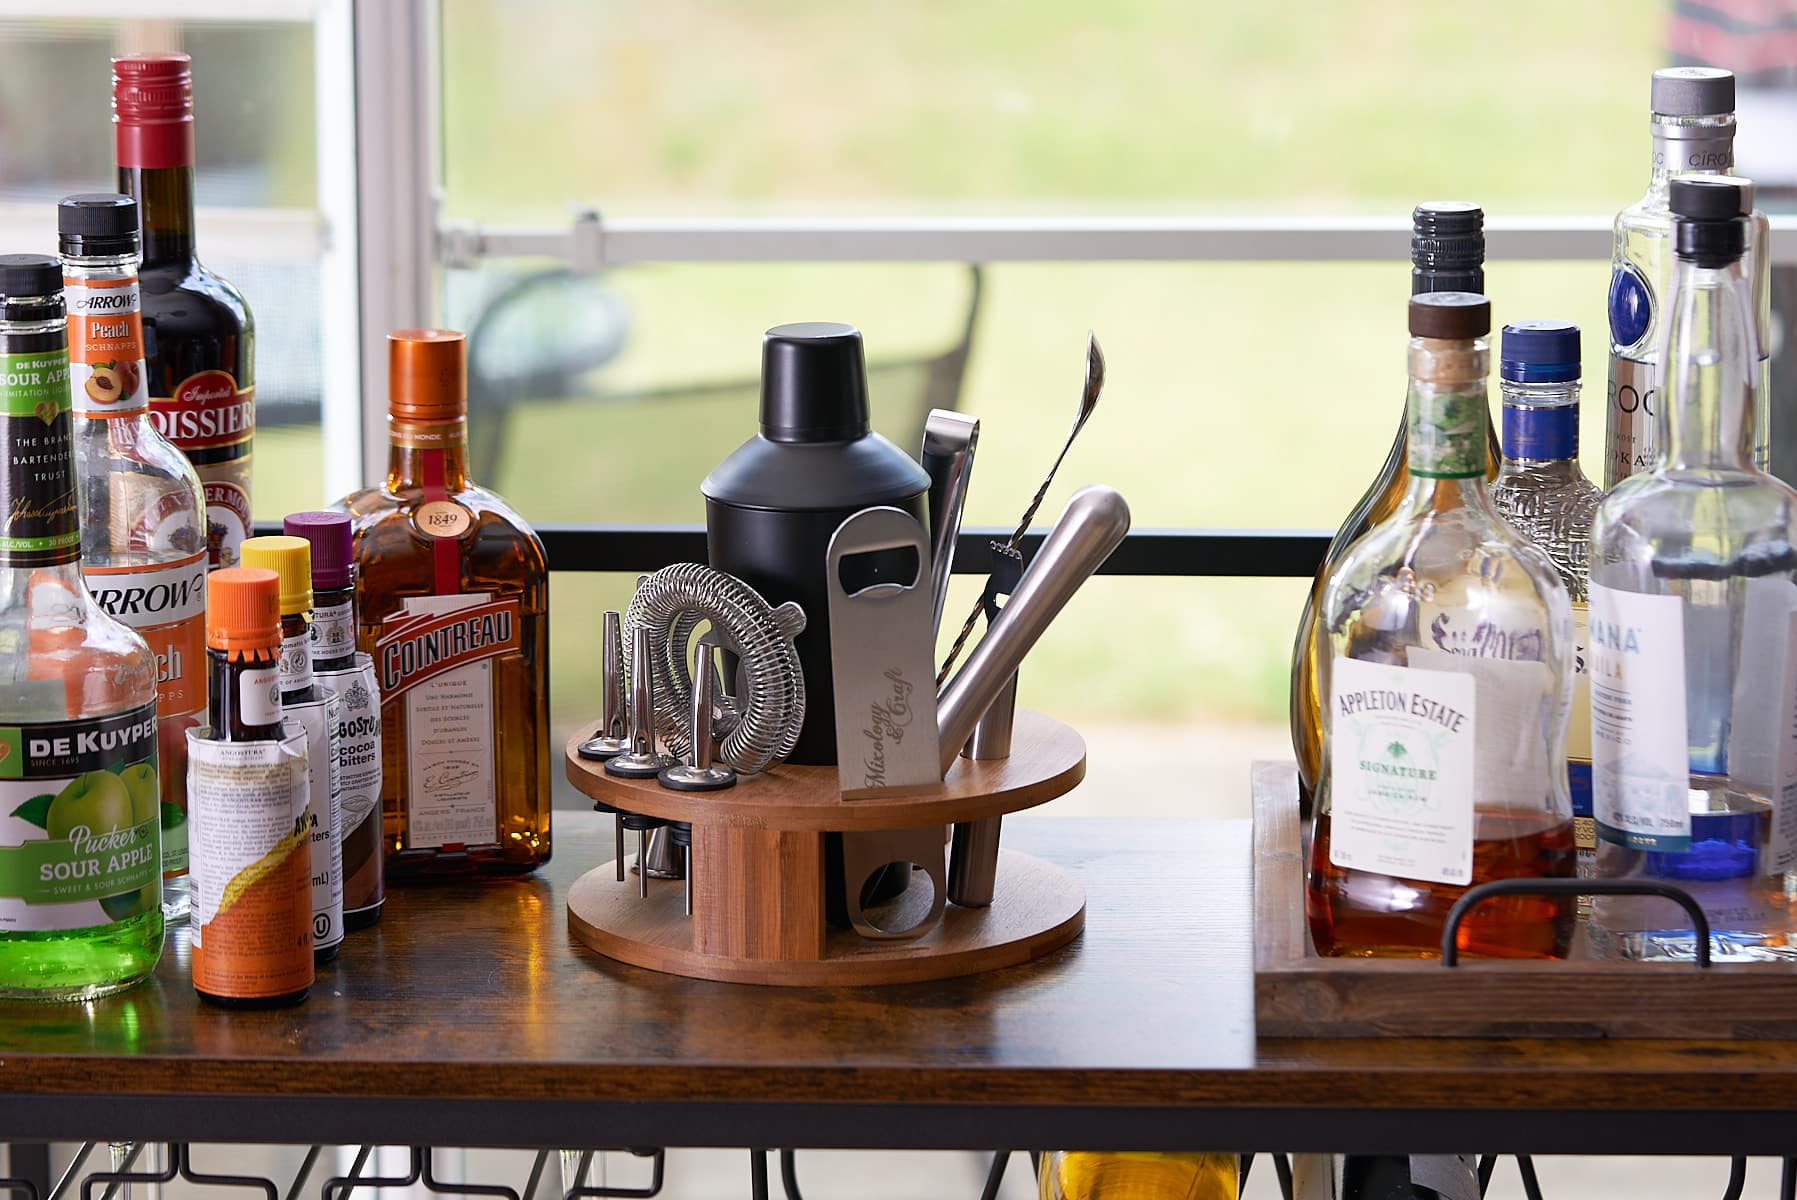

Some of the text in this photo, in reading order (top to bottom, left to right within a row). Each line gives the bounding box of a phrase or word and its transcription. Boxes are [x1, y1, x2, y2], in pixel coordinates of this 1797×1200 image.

[1688, 150, 1729, 167] CÎRO
[77, 293, 137, 309] ARROW
[91, 321, 129, 339] Peach
[15, 362, 31, 370] DE
[150, 400, 255, 440] OISSIER
[16, 434, 69, 447] THE BRAN
[34, 470, 65, 481] TRUST
[427, 514, 458, 526] 1849
[383, 610, 512, 690] COINTREAU
[1339, 690, 1407, 717] APPLETON
[1411, 693, 1465, 733] ESTATE
[29, 717, 157, 758] DE KUYPER
[863, 701, 891, 788] Mixology
[340, 741, 376, 756] cocoa
[31, 757, 58, 767] SINCE
[340, 752, 376, 767] bitters
[1359, 760, 1438, 781] SIGNATURE
[68, 823, 137, 856] Pucker
[39, 859, 101, 882] SOUR
[106, 843, 153, 874] APPLE
[53, 885, 81, 895] SWEET
[94, 879, 114, 889] SOUR
